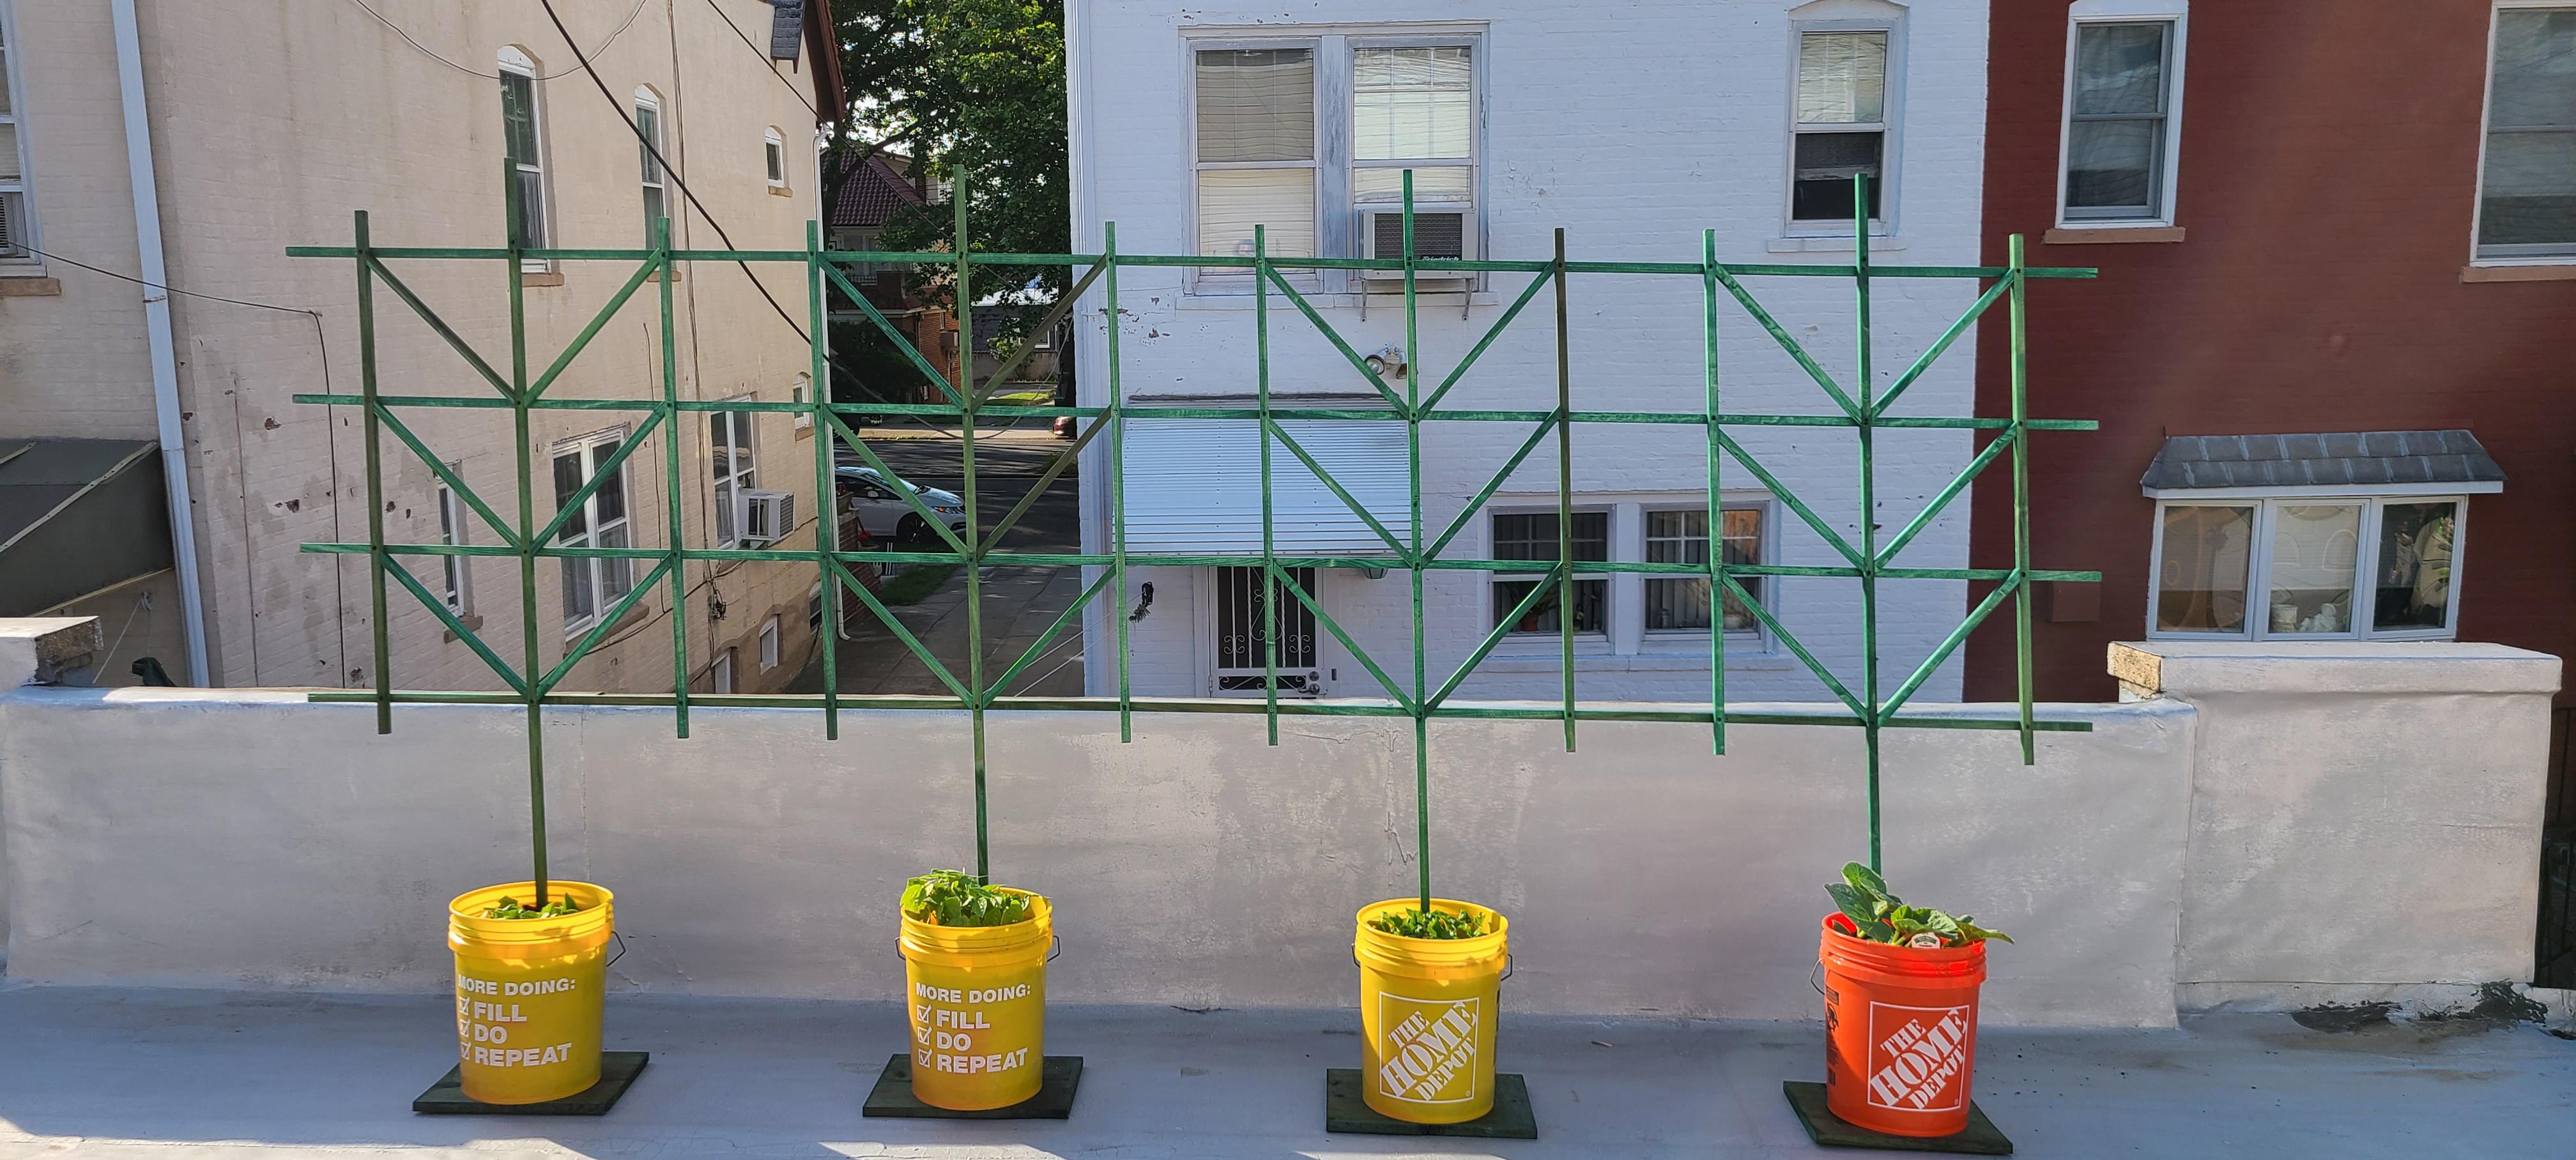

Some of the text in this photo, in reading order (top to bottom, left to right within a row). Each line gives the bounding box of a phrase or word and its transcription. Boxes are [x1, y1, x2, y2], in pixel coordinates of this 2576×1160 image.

[459, 974, 576, 995] MORE DOING:
[916, 982, 1031, 1004] MORE DOING:
[474, 1002, 527, 1022] FILL
[937, 1009, 990, 1029] FILL
[474, 1024, 507, 1044] DO
[937, 1031, 971, 1051] DO
[1388, 1011, 1430, 1048] THE
[1880, 1018, 1926, 1058] THE
[475, 1042, 572, 1067] REPEAT
[937, 1047, 1027, 1074] REPEAT
[1381, 1001, 1477, 1097] HOME
[1870, 1009, 1966, 1107] HOME
[1414, 1037, 1475, 1101] DEPOT
[1908, 1045, 1965, 1110] DEPOT
